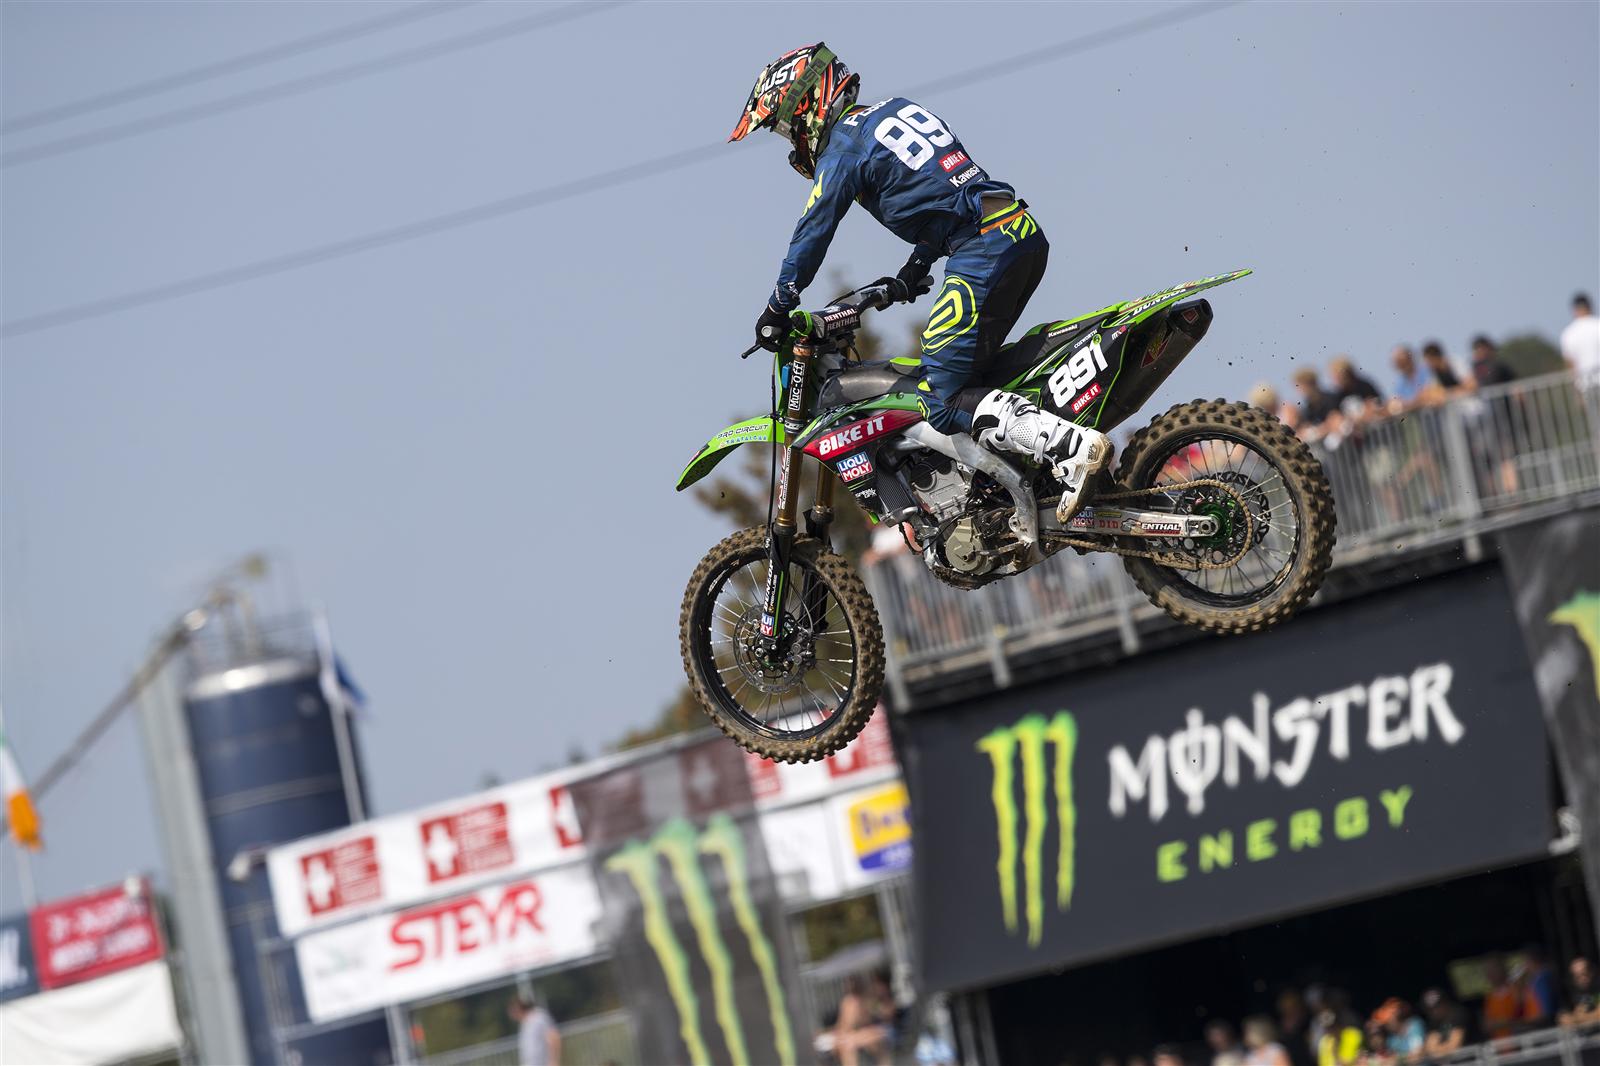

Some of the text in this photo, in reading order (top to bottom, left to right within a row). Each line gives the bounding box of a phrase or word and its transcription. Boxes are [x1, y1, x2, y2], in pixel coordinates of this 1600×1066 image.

[823, 308, 858, 322] RENTHAL
[1048, 324, 1078, 338] Kawasaki
[789, 361, 805, 410] Muc-Off
[1048, 337, 1109, 408] 891
[1073, 384, 1100, 411] BIKE IT
[735, 424, 769, 434] CIRCUIT
[819, 416, 885, 456] BIKE IT
[839, 453, 868, 471] LIQUI
[842, 462, 871, 481] MOLY
[1140, 522, 1182, 531] ENTHAL
[1107, 661, 1465, 822] MONSTER
[1156, 785, 1413, 883] ENERGY
[387, 880, 545, 973] STEYR
